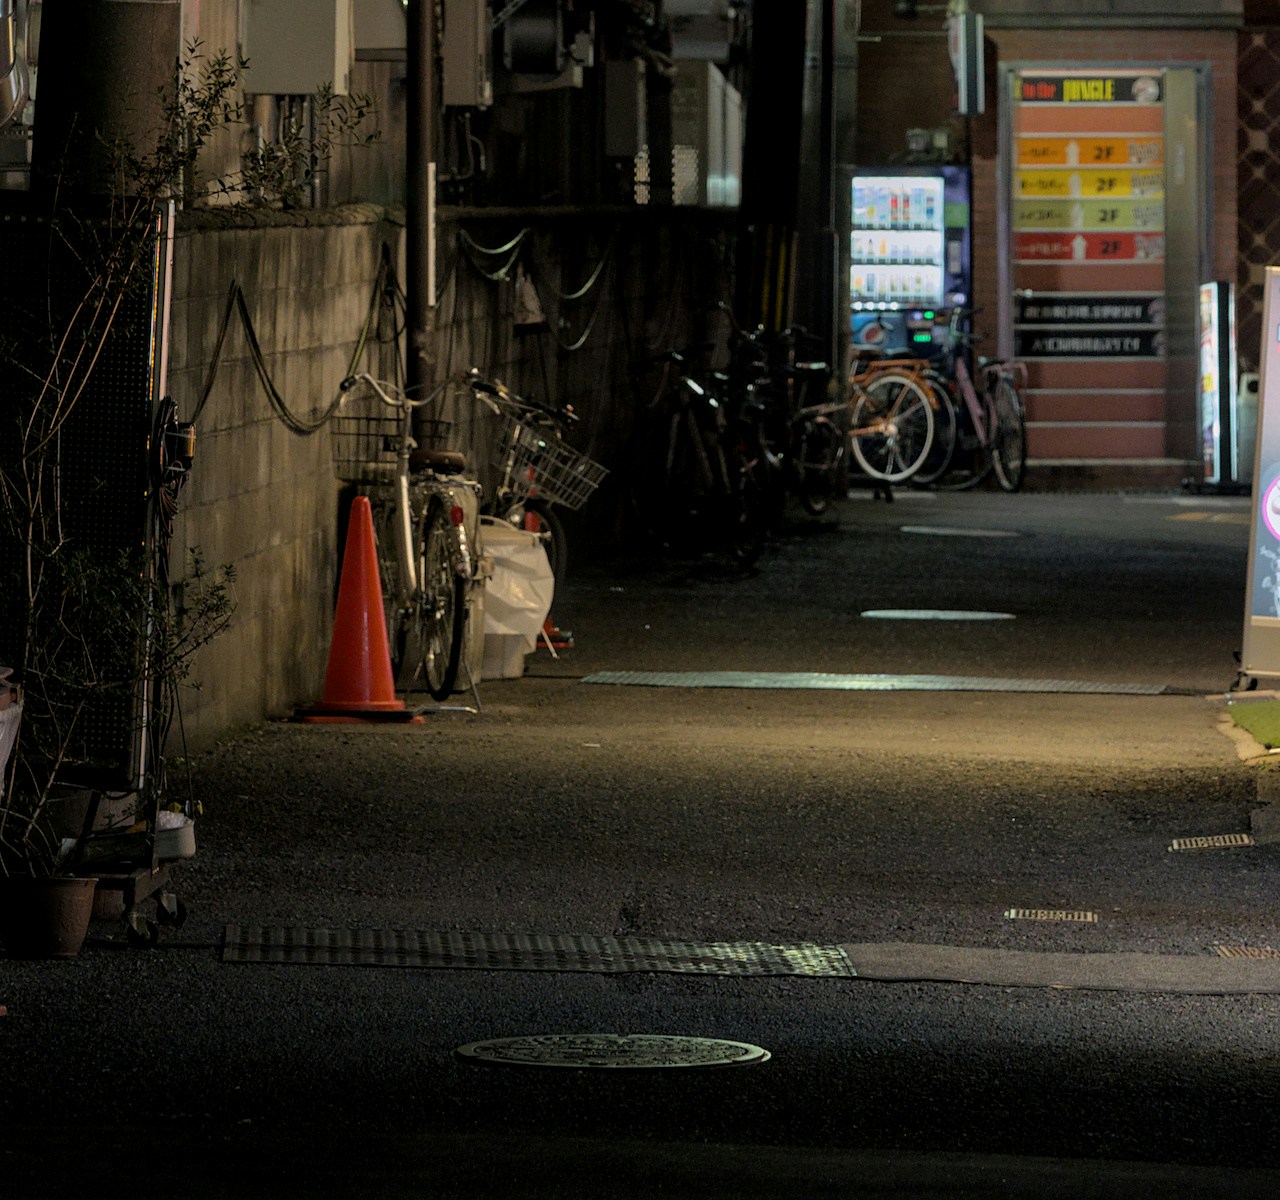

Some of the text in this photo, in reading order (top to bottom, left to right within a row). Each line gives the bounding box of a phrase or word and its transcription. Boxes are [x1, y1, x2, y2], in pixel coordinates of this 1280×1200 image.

[1093, 146, 1115, 161] 2F
[1096, 177, 1119, 192] 2F
[1098, 209, 1120, 223] 2F
[1100, 240, 1122, 256] 2F
